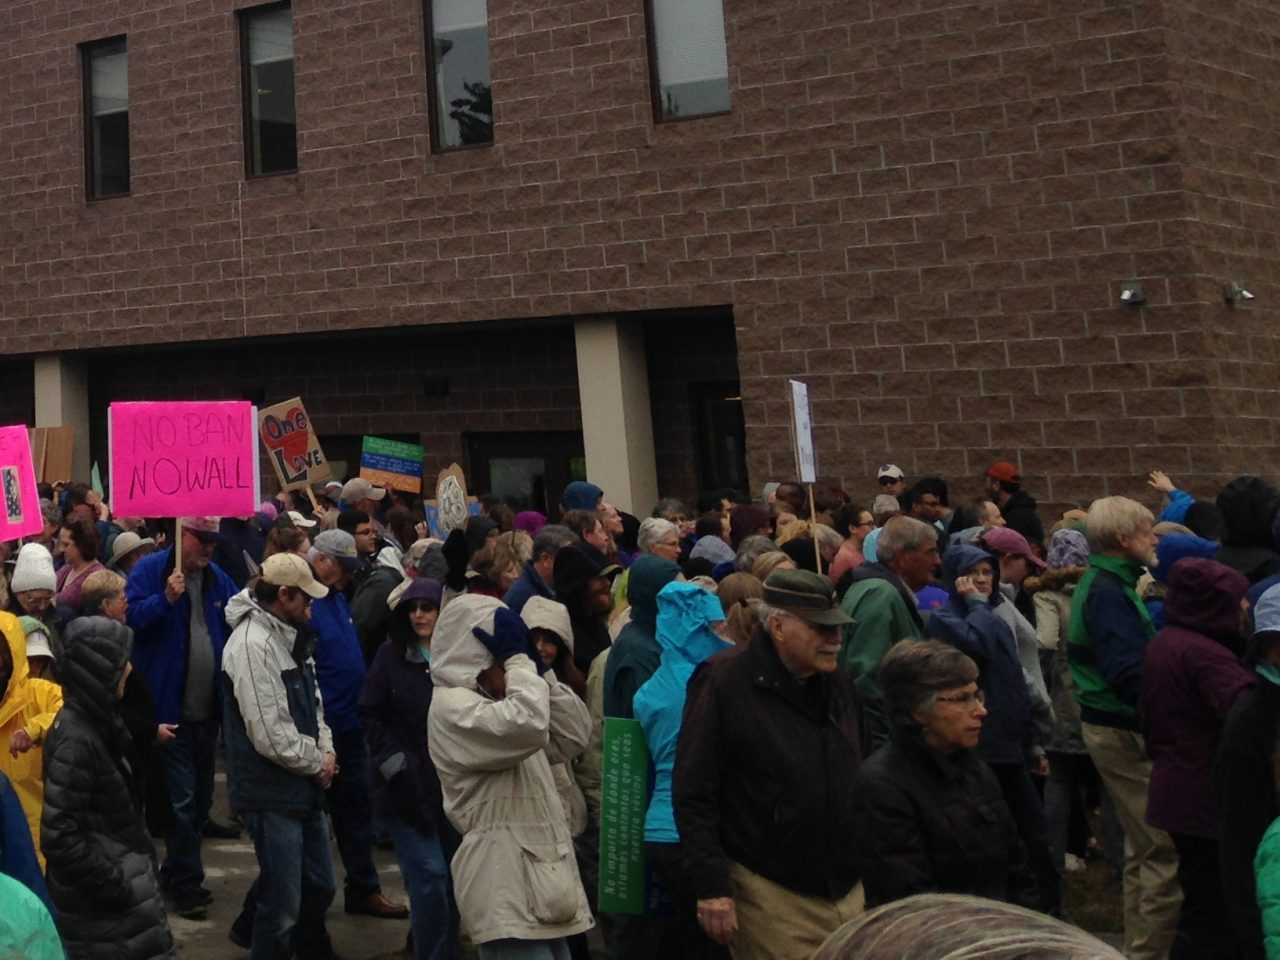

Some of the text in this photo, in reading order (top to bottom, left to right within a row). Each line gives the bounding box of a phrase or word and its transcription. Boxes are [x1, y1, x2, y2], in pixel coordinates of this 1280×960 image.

[132, 412, 245, 453] NO BAN
[264, 413, 307, 439] One
[129, 455, 249, 499] NO WALL
[605, 809, 617, 822] de
[607, 828, 618, 873] importa
[603, 879, 616, 895] No
